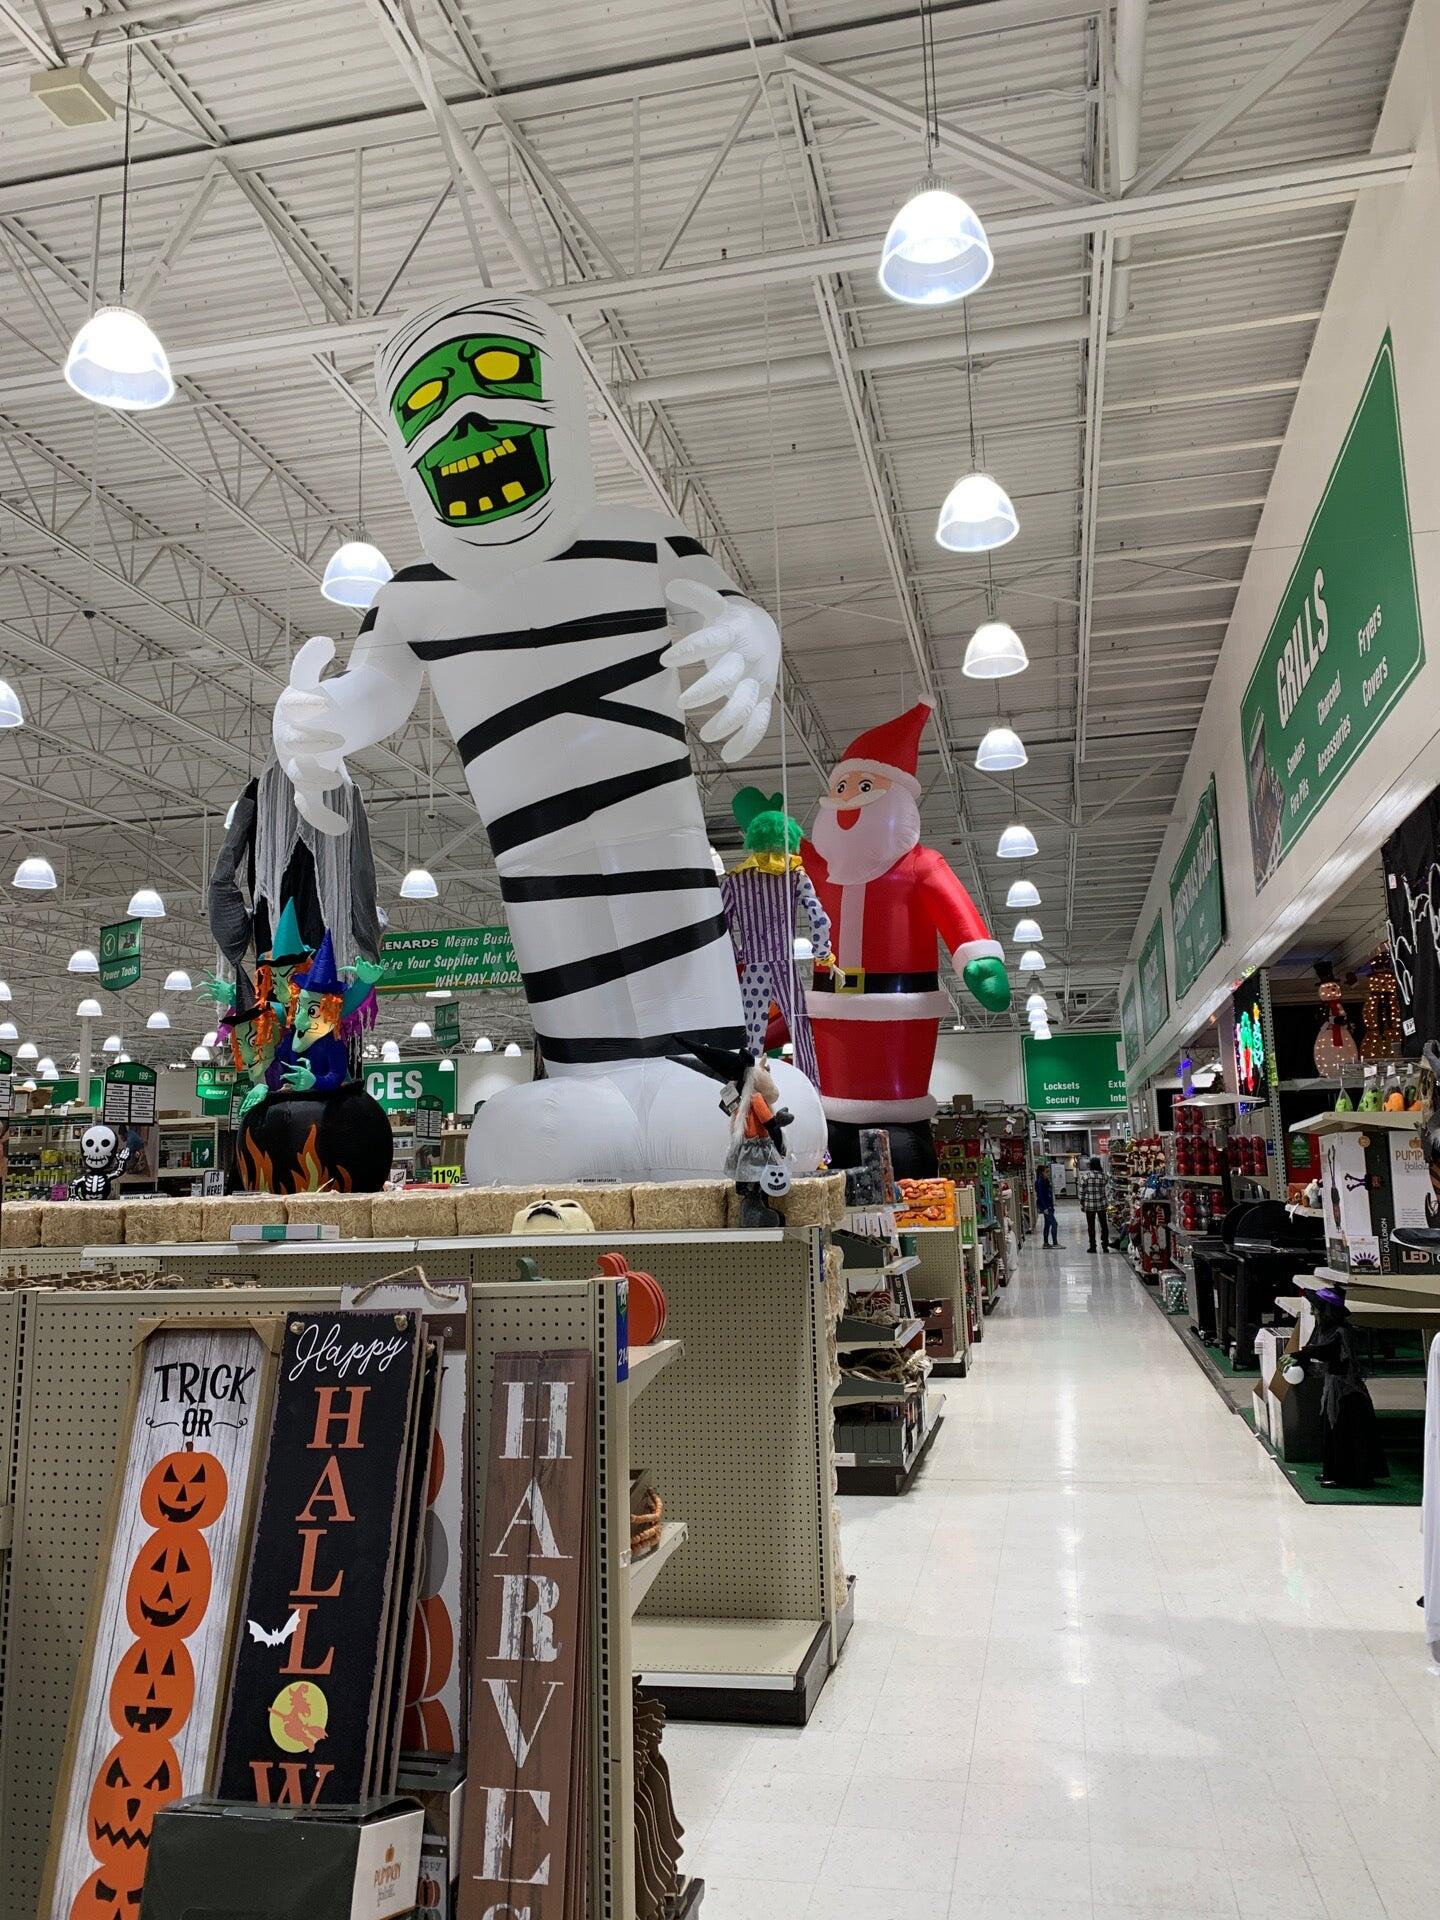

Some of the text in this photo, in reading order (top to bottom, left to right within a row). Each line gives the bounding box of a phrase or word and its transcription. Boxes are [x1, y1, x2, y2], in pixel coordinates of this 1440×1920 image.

[1357, 603, 1383, 658] Fryers
[1276, 567, 1329, 730] GRILLS
[1317, 669, 1342, 726] Charcoal
[1362, 655, 1389, 708] Covers
[1286, 737, 1306, 779] Smokers
[1317, 713, 1351, 777] Accessories
[382, 938, 439, 950] ENARDS
[445, 935, 479, 948] Means
[121, 964, 138, 977] Tools
[407, 955, 431, 970] Your
[433, 954, 479, 971] Supplier
[482, 951, 502, 965] Not
[434, 973, 462, 988] WHY
[464, 972, 488, 987] PAY
[205, 1088, 228, 1096] Grocery
[366, 1069, 424, 1101] CES
[1043, 1081, 1080, 1091] Locksets
[1045, 1095, 1080, 1105] Security
[433, 1169, 460, 1184] 11%
[1380, 1217, 1390, 1253] CAULDRON
[1402, 1250, 1430, 1264] LED
[288, 1323, 408, 1382] Happy
[154, 1361, 257, 1405] TRICK
[181, 1407, 214, 1438] OR
[472, 1381, 576, 1920] HARVE
